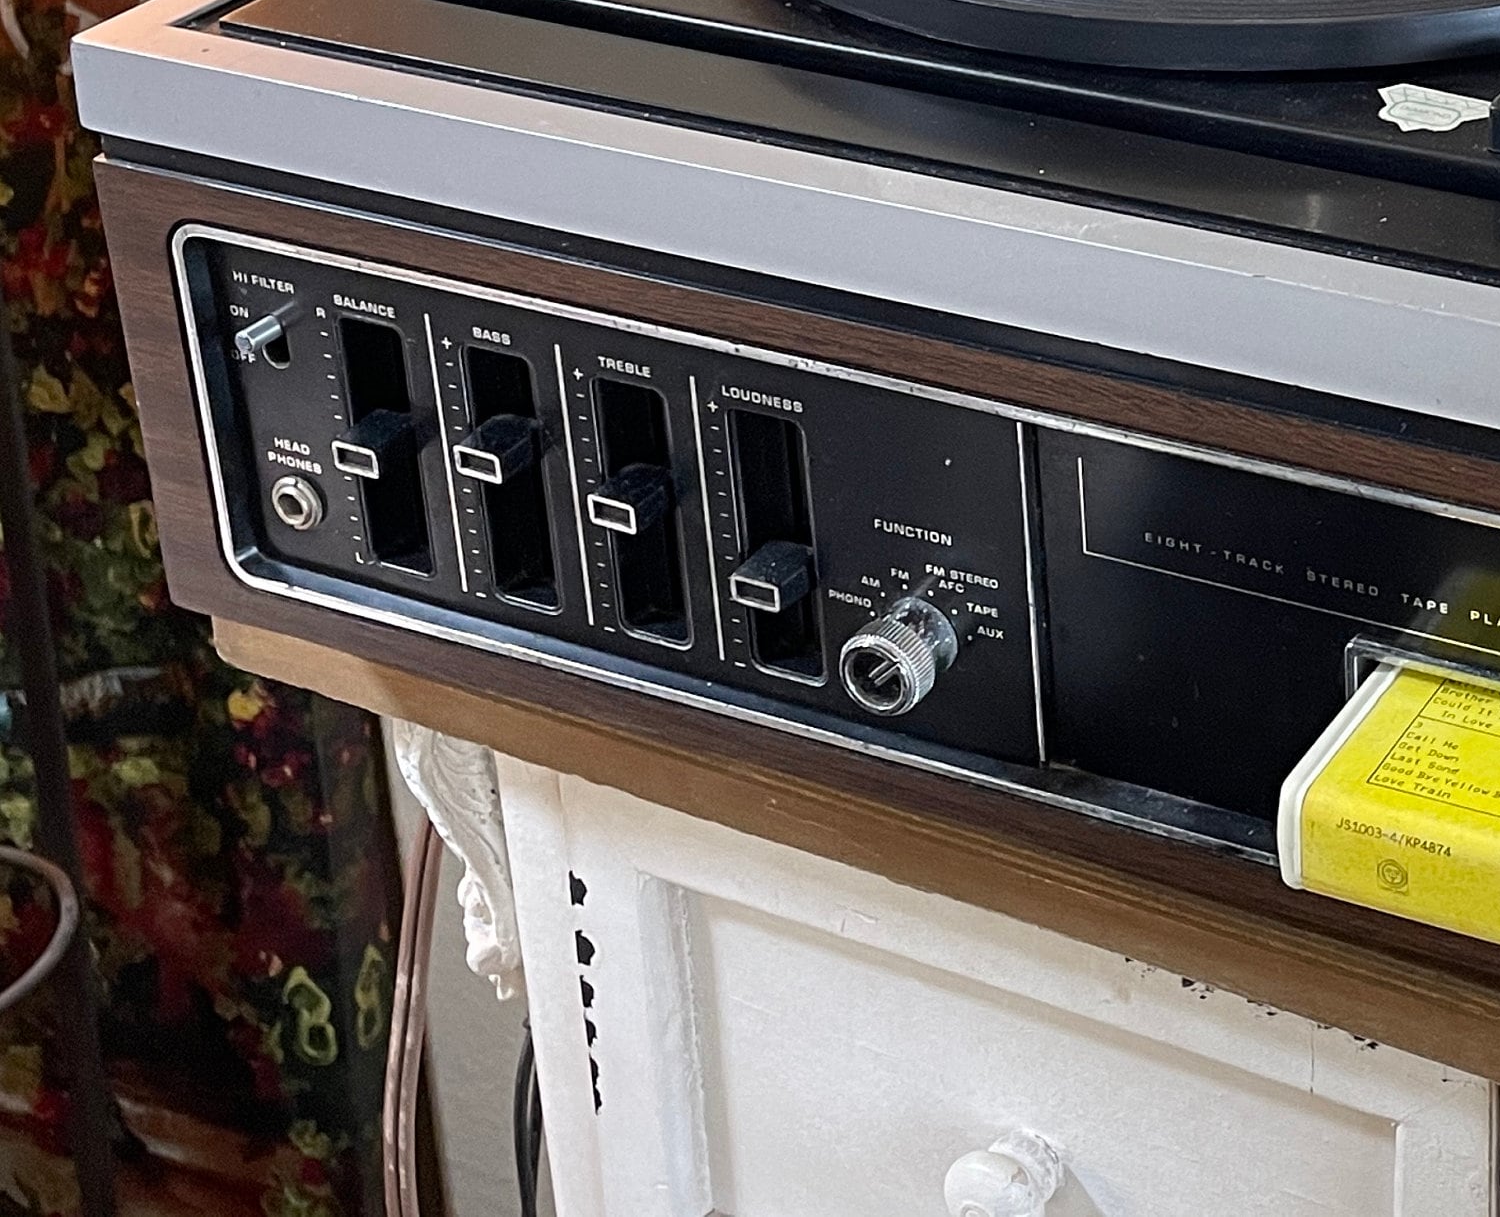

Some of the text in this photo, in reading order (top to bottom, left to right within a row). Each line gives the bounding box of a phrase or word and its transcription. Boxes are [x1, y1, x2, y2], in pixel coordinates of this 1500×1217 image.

[233, 271, 295, 294] HI FILTER
[229, 305, 249, 318] ON
[317, 307, 326, 318] R
[333, 294, 396, 319] BALANCE
[472, 327, 511, 345] BASS
[598, 356, 651, 378] TREBLE
[722, 385, 803, 413] LOUDNESS
[274, 437, 310, 455] HEAD
[267, 451, 322, 474] PHONES
[874, 518, 953, 546] FUNCTION
[355, 552, 364, 564] L
[861, 575, 881, 588] AM
[890, 567, 910, 581] FM
[925, 564, 999, 589] FM STEREO
[938, 579, 965, 594] AFC
[1307, 570, 1379, 598] STEREO
[1401, 593, 1449, 615] TAPE
[828, 589, 872, 608] PHONO
[966, 602, 999, 618] TAPE
[977, 625, 1004, 640] AUX
[1463, 716, 1493, 729] Love
[1406, 732, 1436, 745] Call
[1390, 752, 1421, 766] Last
[1374, 773, 1451, 799] Love Train
